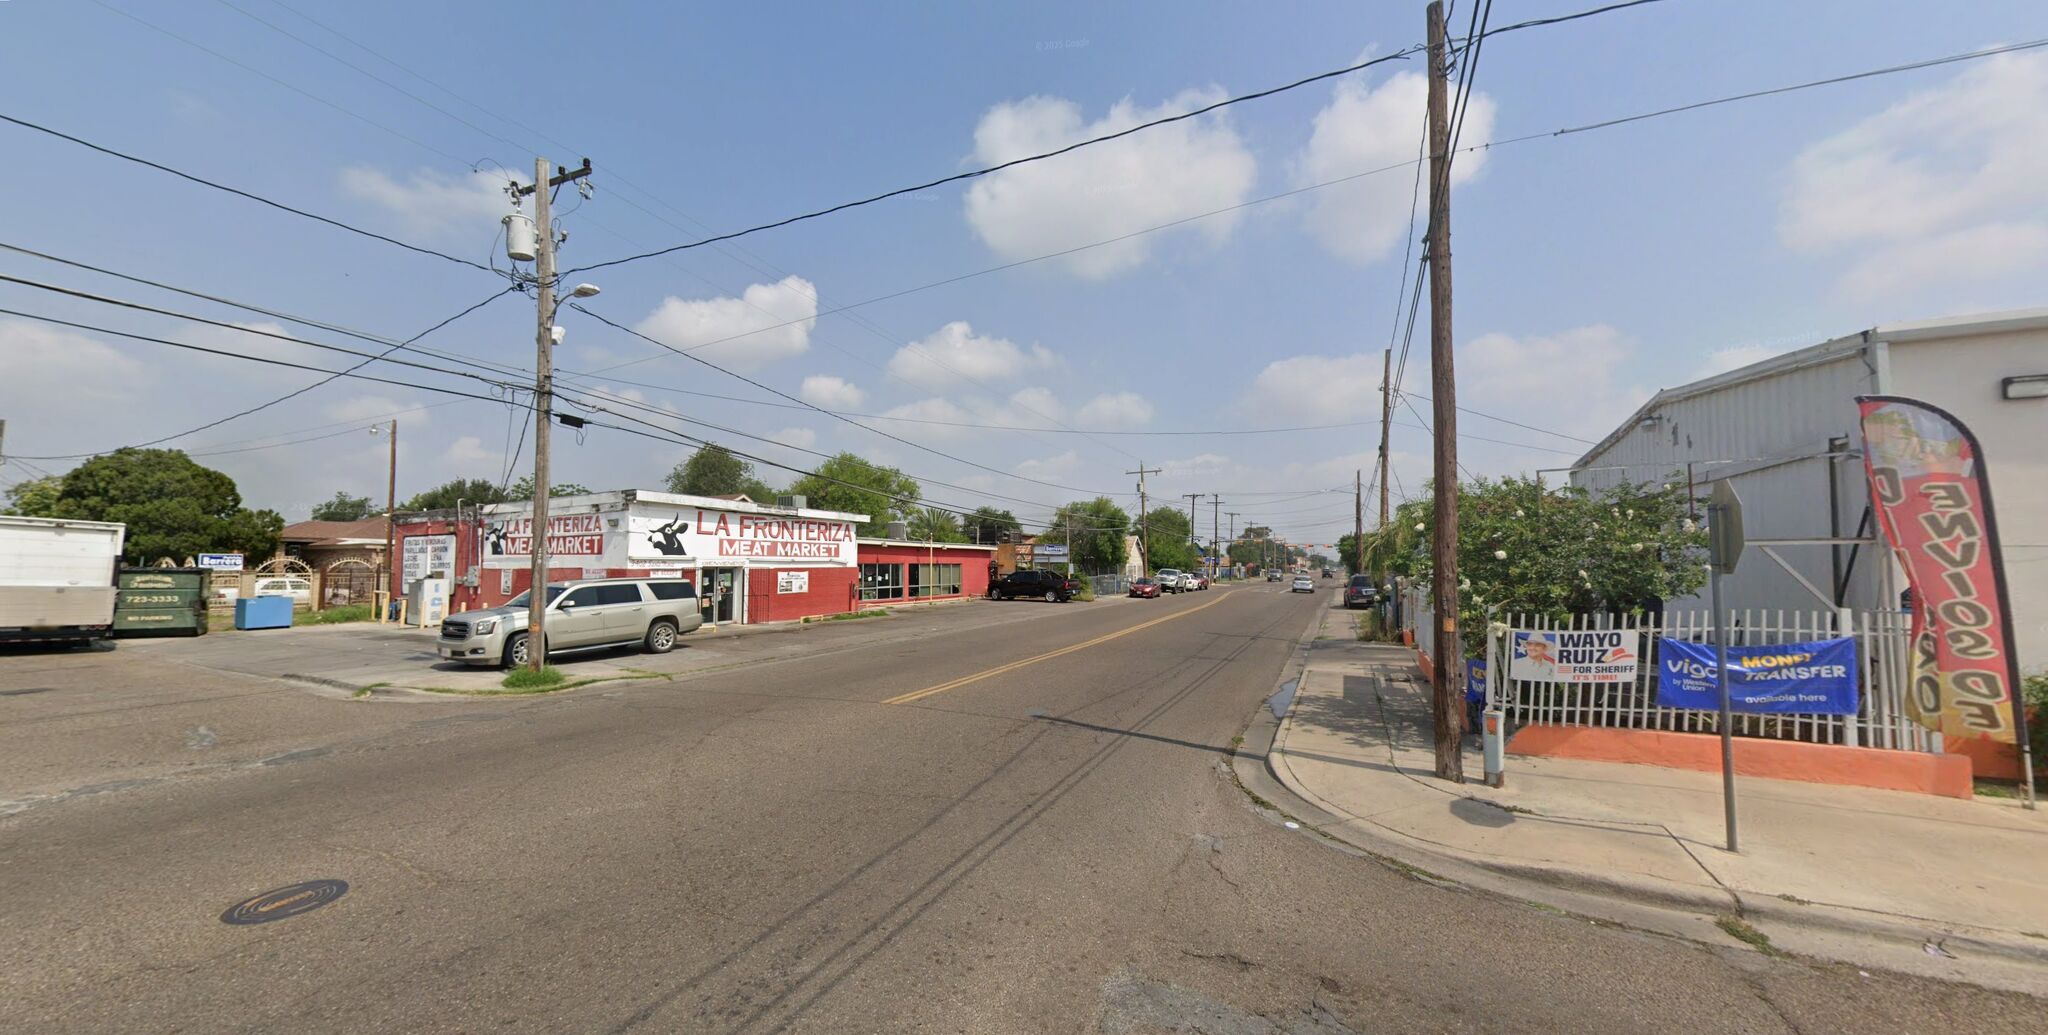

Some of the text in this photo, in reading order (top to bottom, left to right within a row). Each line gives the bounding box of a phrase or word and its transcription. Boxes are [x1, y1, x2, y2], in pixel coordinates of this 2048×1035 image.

[506, 516, 602, 534] LA FNTERIZA
[697, 511, 852, 542] LA FRONTERIZA
[507, 536, 533, 553] MEA
[722, 540, 837, 557] MEAT MARKET
[126, 595, 179, 603] 723-3333
[1560, 632, 1621, 648] WAYO
[1558, 649, 1608, 664] RUIZ
[1594, 665, 1634, 673] SHERIFF
[1745, 665, 1846, 681] TRANSFER
[1673, 678, 1681, 686] by
[1799, 694, 1827, 702] here
